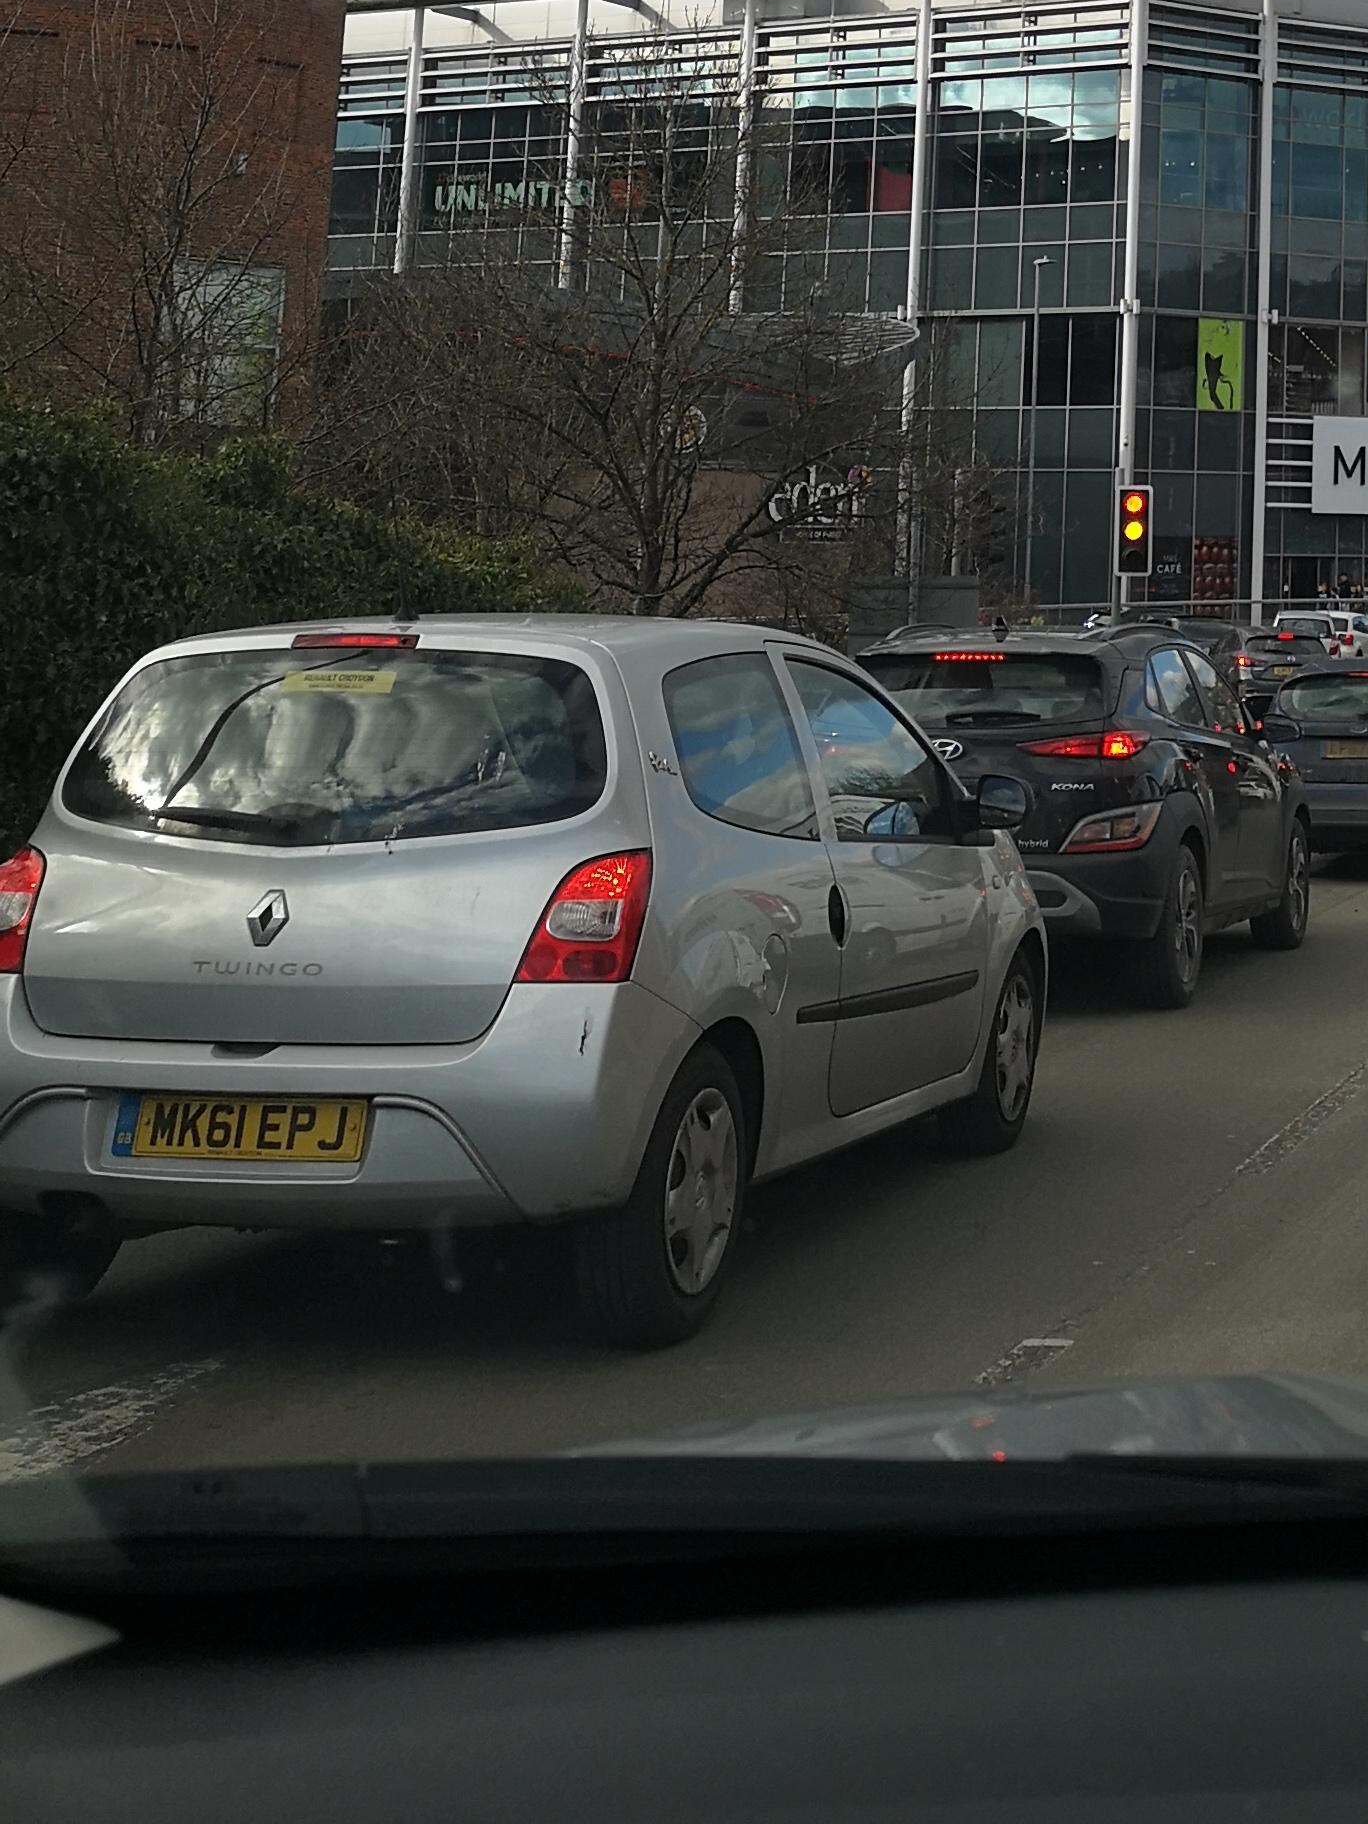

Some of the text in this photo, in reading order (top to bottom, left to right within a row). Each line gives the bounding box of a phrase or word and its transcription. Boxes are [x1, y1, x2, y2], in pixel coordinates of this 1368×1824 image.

[1156, 562, 1183, 574] CAFÉ
[1050, 783, 1095, 791] KONA
[1017, 839, 1049, 849] hybrid
[192, 960, 323, 976] TWINGO
[149, 1102, 248, 1149] MK61
